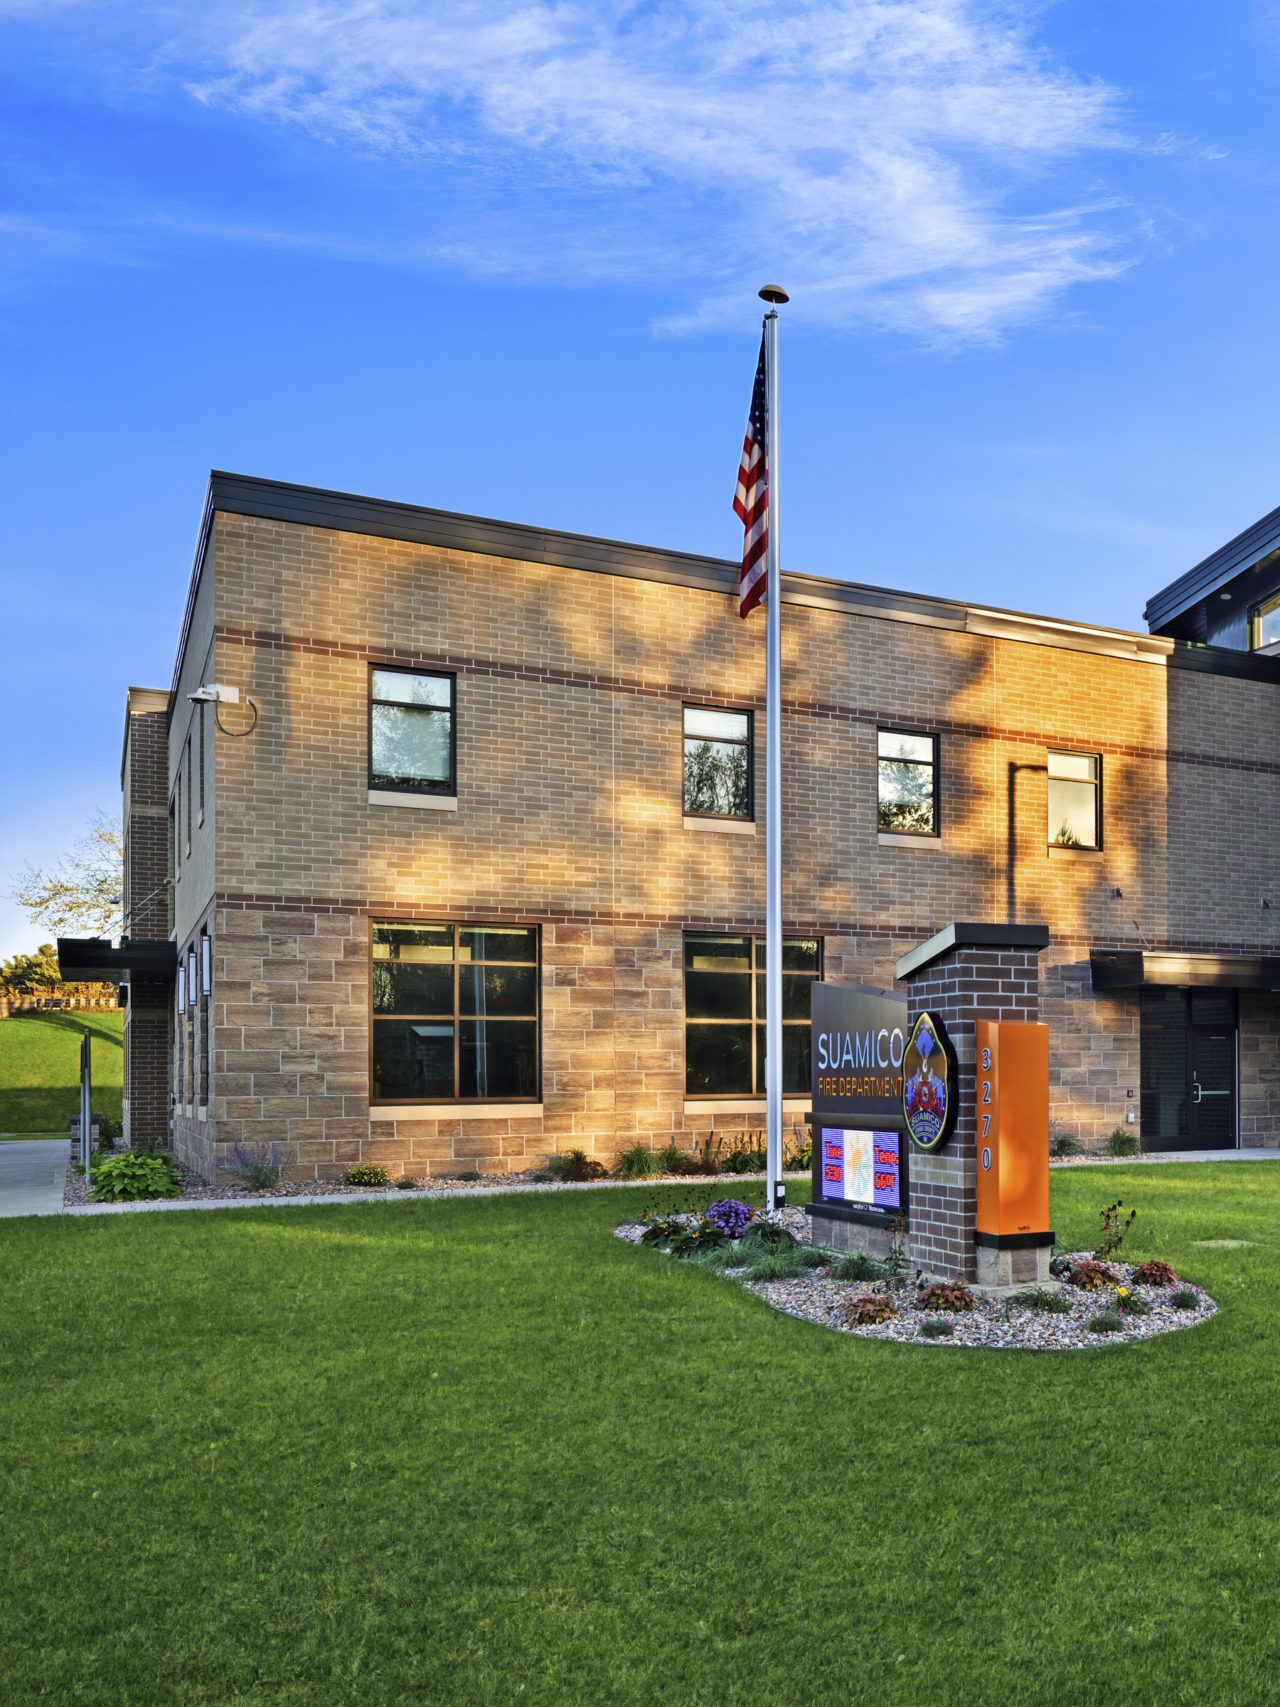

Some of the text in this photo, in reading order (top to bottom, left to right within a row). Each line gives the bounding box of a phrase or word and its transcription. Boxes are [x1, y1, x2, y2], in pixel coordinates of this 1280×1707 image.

[818, 1027, 904, 1070] SUAMICO
[818, 1076, 903, 1097] FIRE DEPARTMENT
[911, 1111, 940, 1129] SUAMICO
[981, 1047, 991, 1171] 3270
